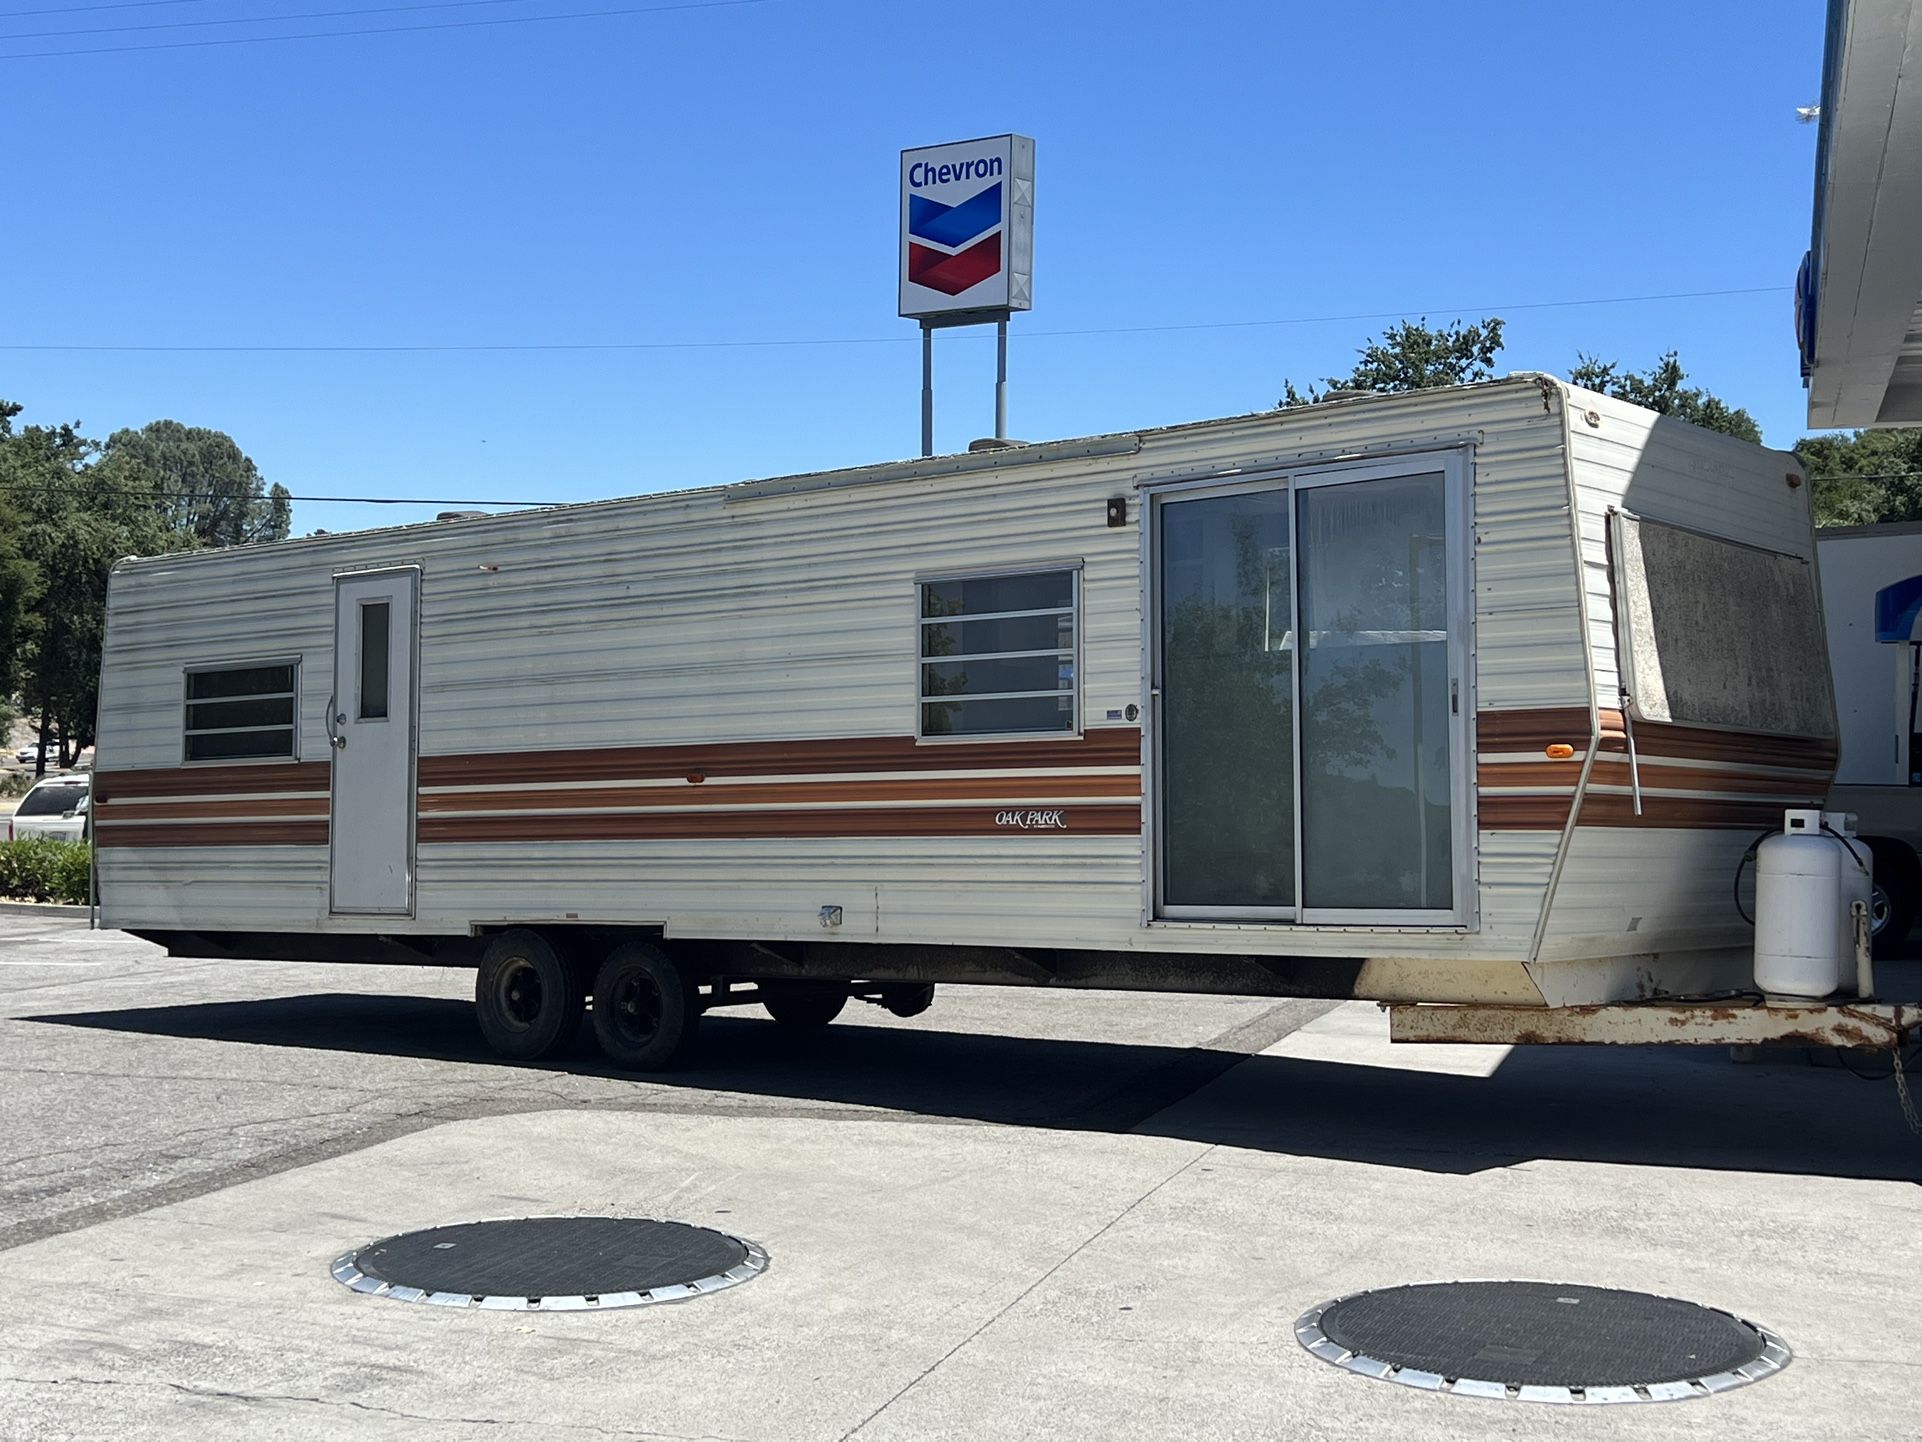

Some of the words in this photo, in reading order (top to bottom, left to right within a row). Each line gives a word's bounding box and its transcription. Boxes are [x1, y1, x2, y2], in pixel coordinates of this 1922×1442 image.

[909, 156, 1002, 188] Chevron
[995, 810, 1028, 828] OAK
[1026, 810, 1067, 828] PARK
